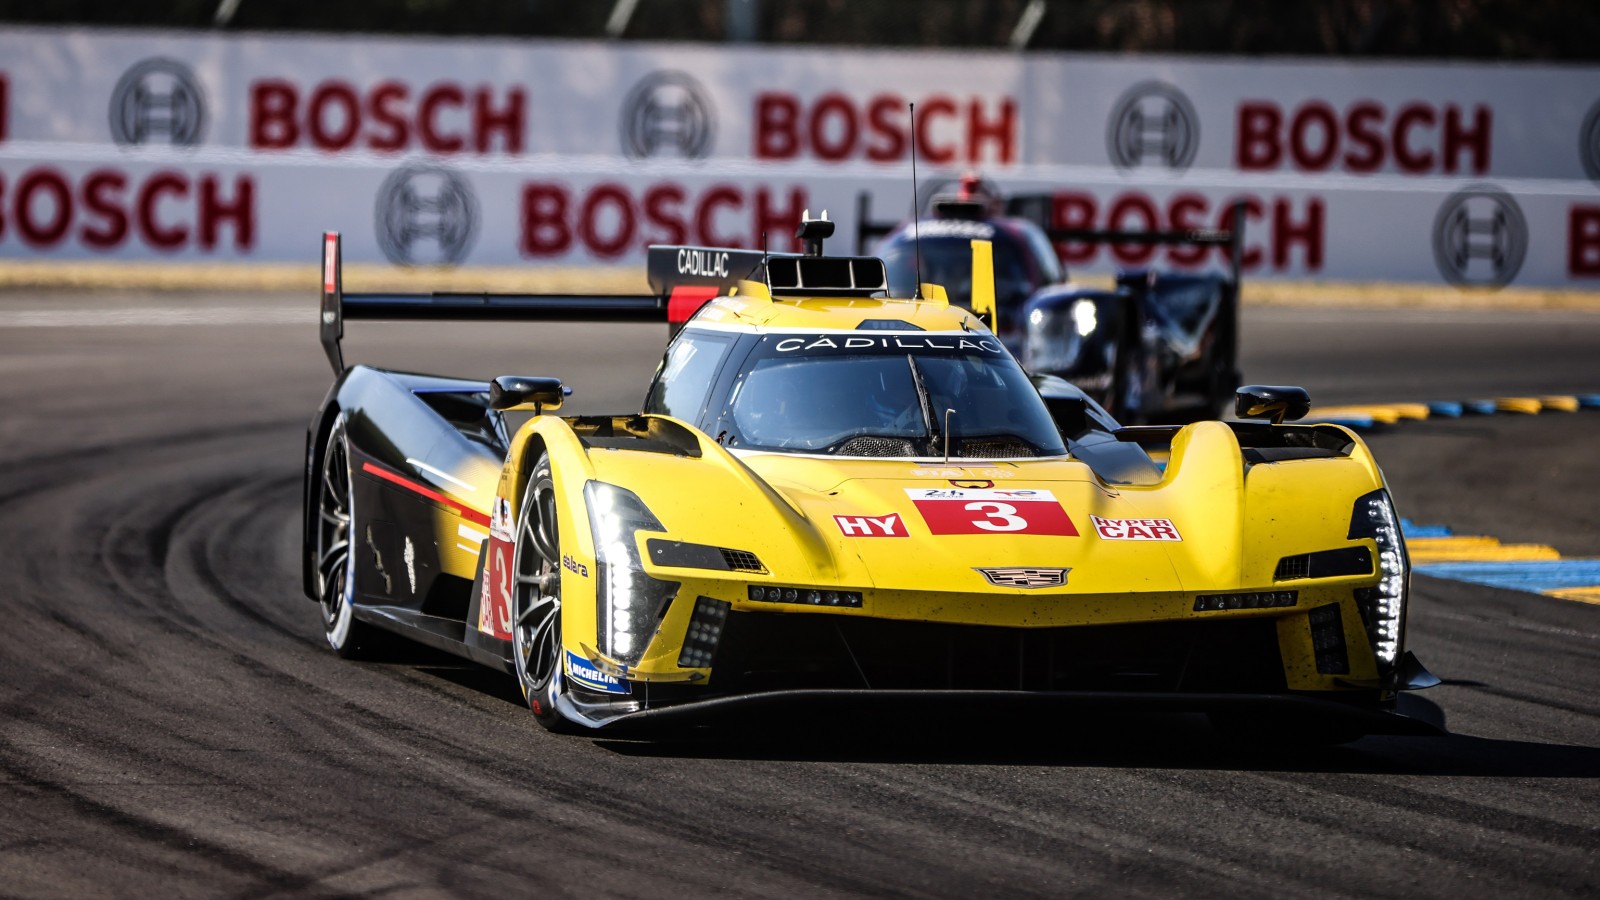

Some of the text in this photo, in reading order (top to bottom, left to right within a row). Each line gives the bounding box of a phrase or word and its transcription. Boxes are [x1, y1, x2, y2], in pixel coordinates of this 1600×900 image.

[249, 81, 527, 155] BOSCH
[753, 91, 1018, 165] BOSCH
[1236, 102, 1491, 175] BOSCH
[0, 166, 256, 251] OSCH
[520, 181, 807, 257] BOSCH
[1051, 190, 1326, 271] BOSCH
[677, 248, 729, 278] CADILLAC
[775, 337, 1001, 353] CADILLAC
[841, 514, 899, 536] HY
[963, 501, 1028, 532] 3
[1094, 516, 1170, 527] HYPER
[1098, 526, 1178, 539] CAR
[495, 546, 512, 633] 3
